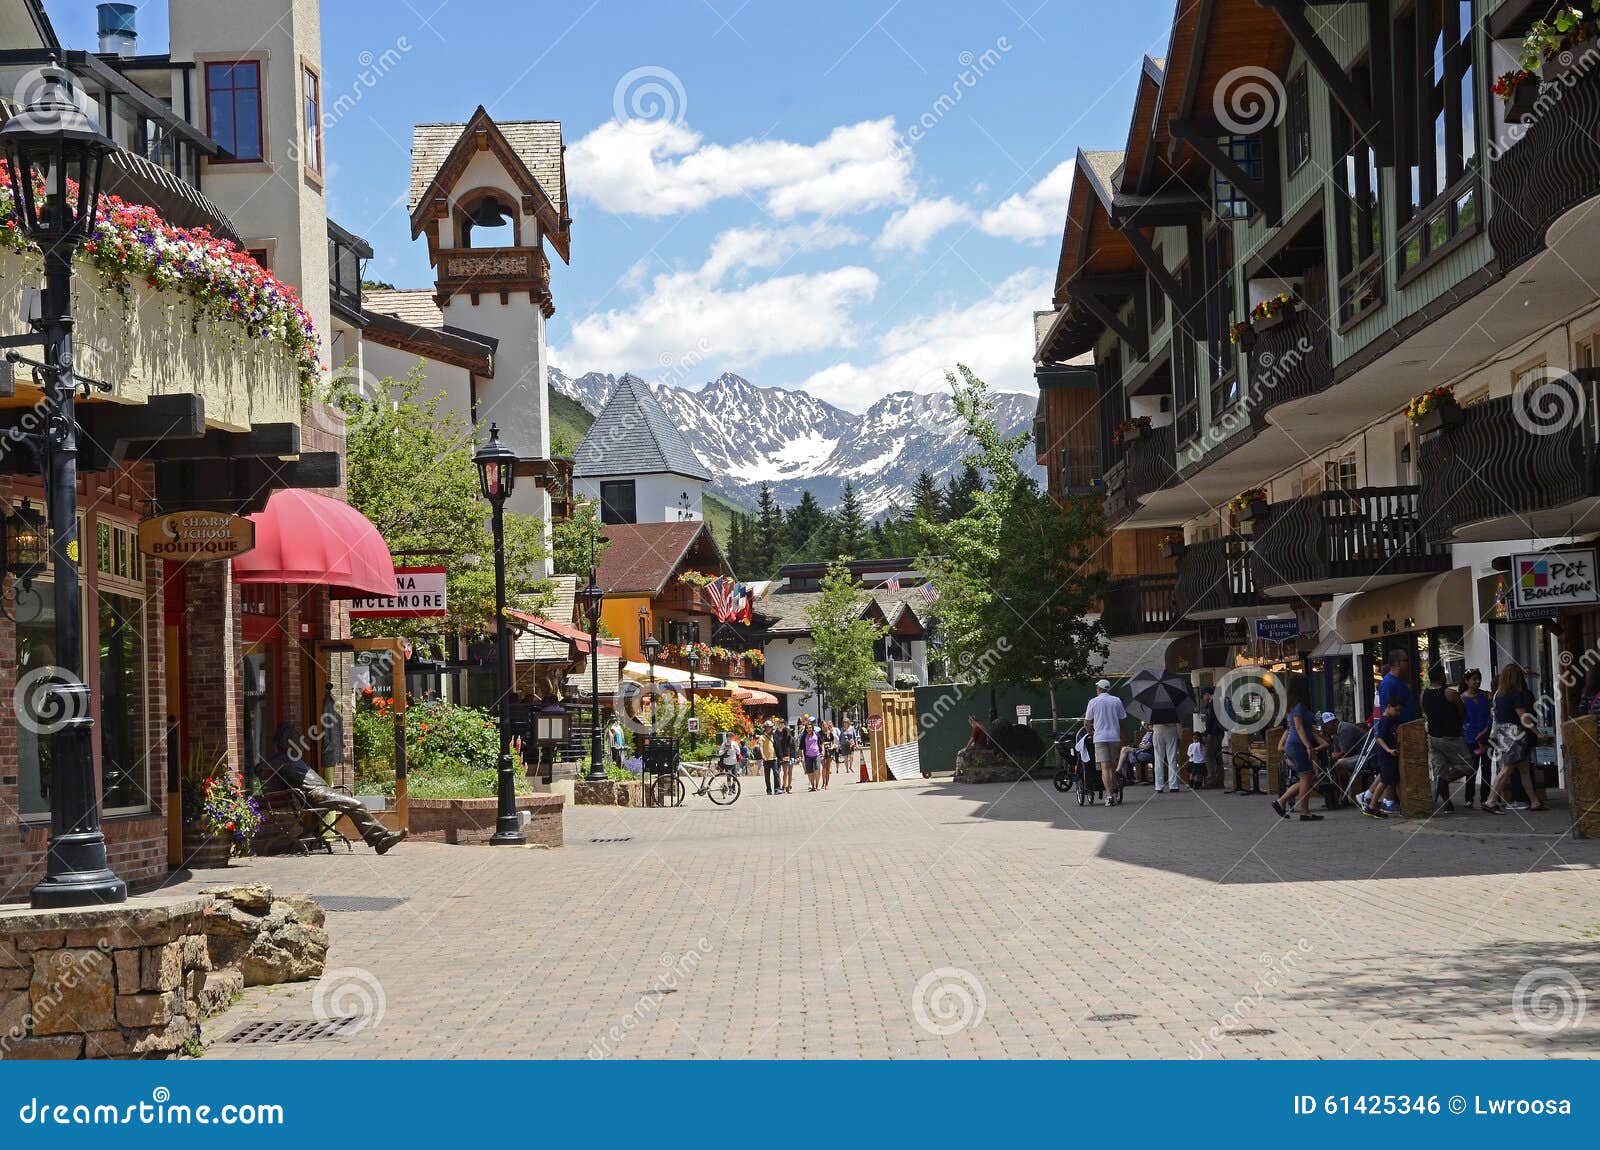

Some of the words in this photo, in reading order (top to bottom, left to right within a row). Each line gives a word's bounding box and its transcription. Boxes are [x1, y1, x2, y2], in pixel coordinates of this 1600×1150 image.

[182, 517, 230, 528] CHARM
[183, 529, 233, 539] SCHOOL
[153, 540, 239, 553] BOUTIQUE
[1550, 561, 1588, 579] Pet
[1522, 580, 1592, 600] Boutique
[352, 594, 442, 608] MCLEMORE
[1269, 630, 1290, 638] Furs
